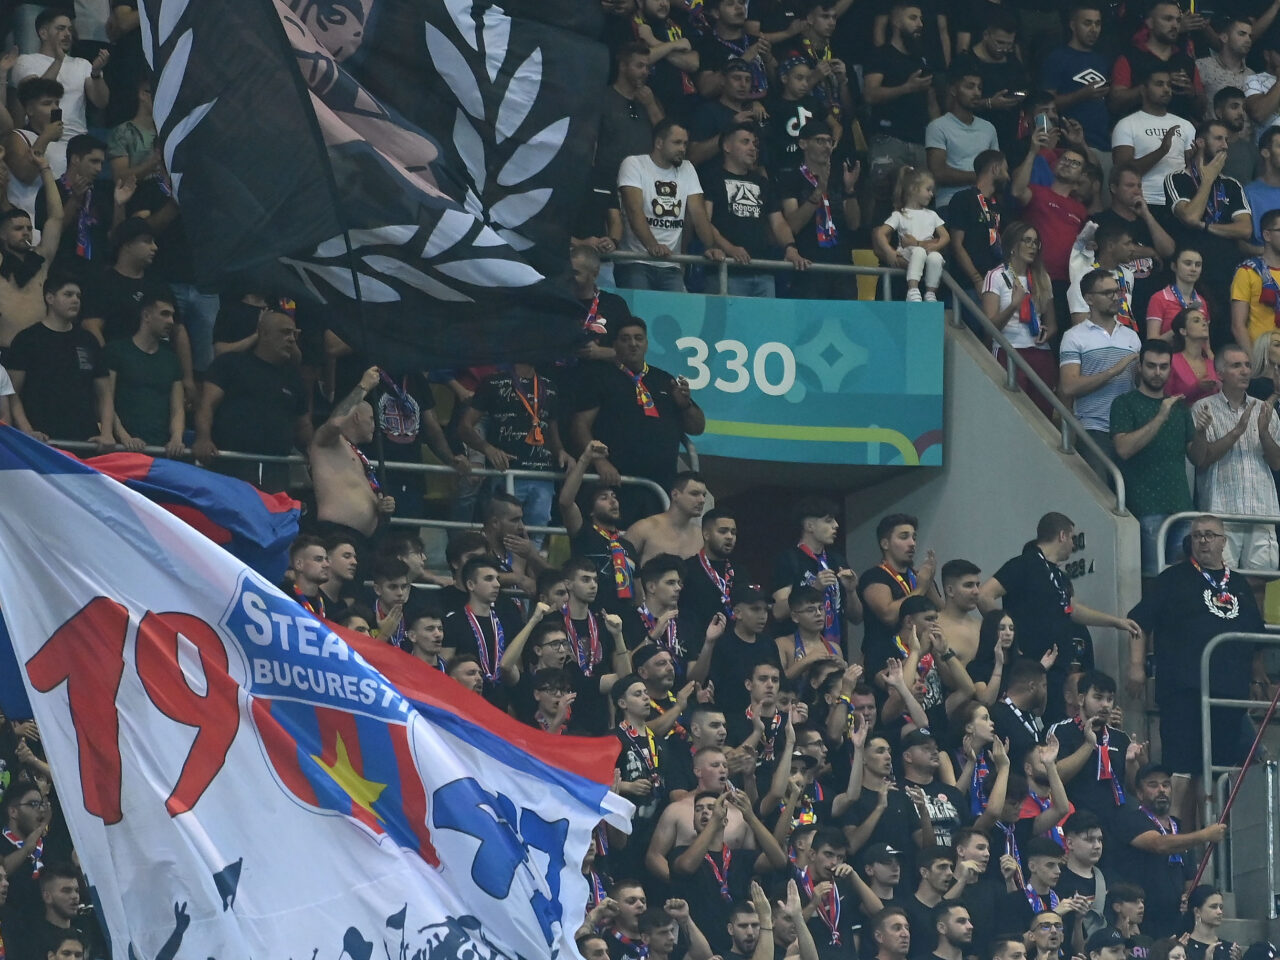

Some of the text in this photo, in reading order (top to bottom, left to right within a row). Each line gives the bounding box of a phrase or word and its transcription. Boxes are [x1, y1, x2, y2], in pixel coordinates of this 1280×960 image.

[1145, 128, 1182, 139] GUES
[675, 336, 797, 396] 330
[242, 591, 380, 677] STEA
